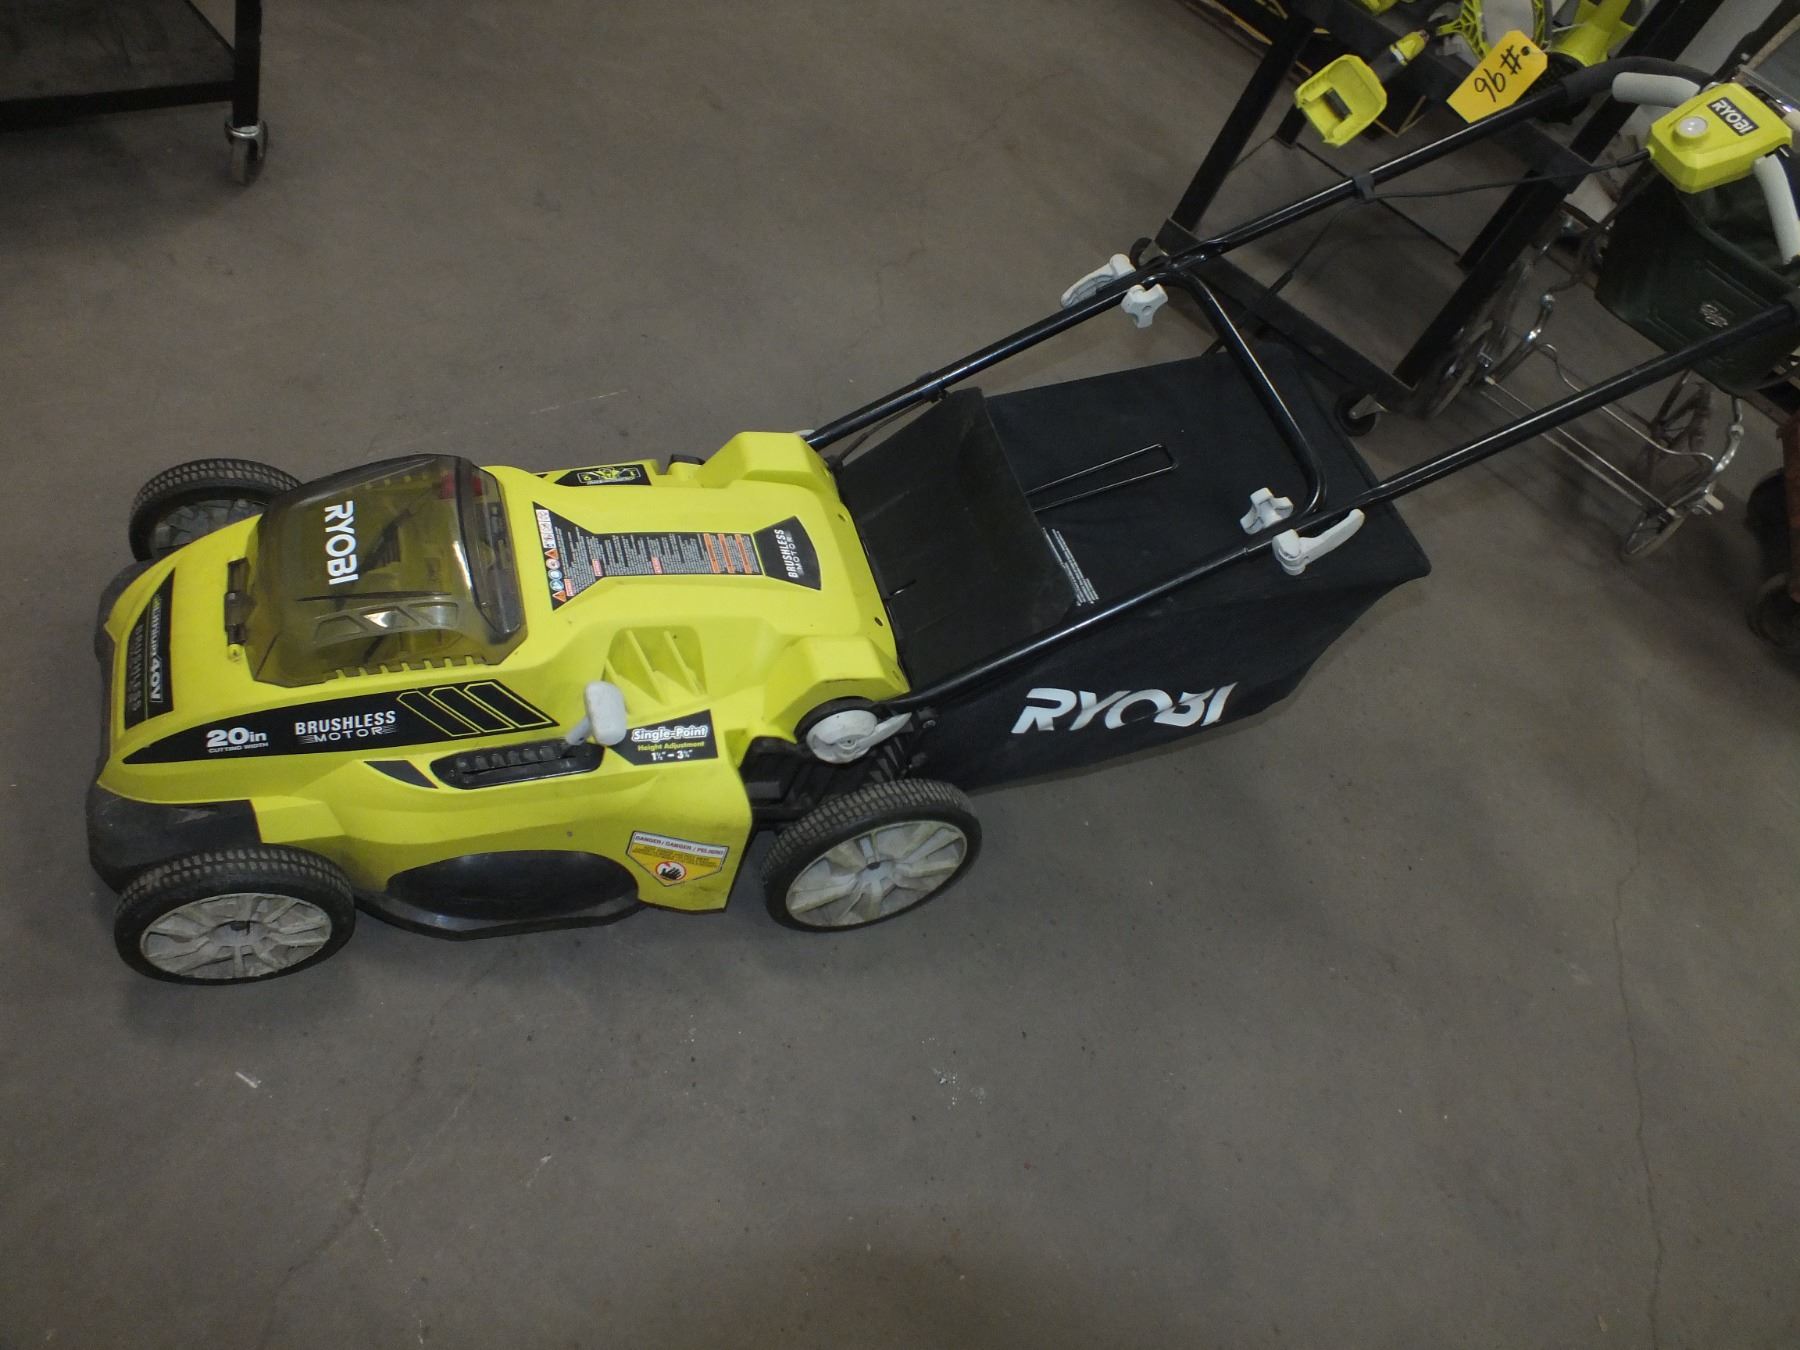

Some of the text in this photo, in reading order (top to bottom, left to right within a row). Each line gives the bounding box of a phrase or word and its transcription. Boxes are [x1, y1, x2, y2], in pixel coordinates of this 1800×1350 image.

[1711, 99, 1753, 134] RYOBI
[324, 500, 359, 585] RYOBI
[774, 529, 799, 578] BRUSHLESS
[786, 536, 804, 571] MOTOR
[150, 657, 162, 699] 40V
[1011, 681, 1238, 734] RYOBI
[206, 727, 267, 748] 20in
[295, 710, 396, 736] BRUSHLESS
[314, 726, 384, 744] MOTOR
[632, 726, 708, 741] Single-Point
[208, 745, 242, 753] CUTTING
[637, 741, 705, 752] Height Adjustment
